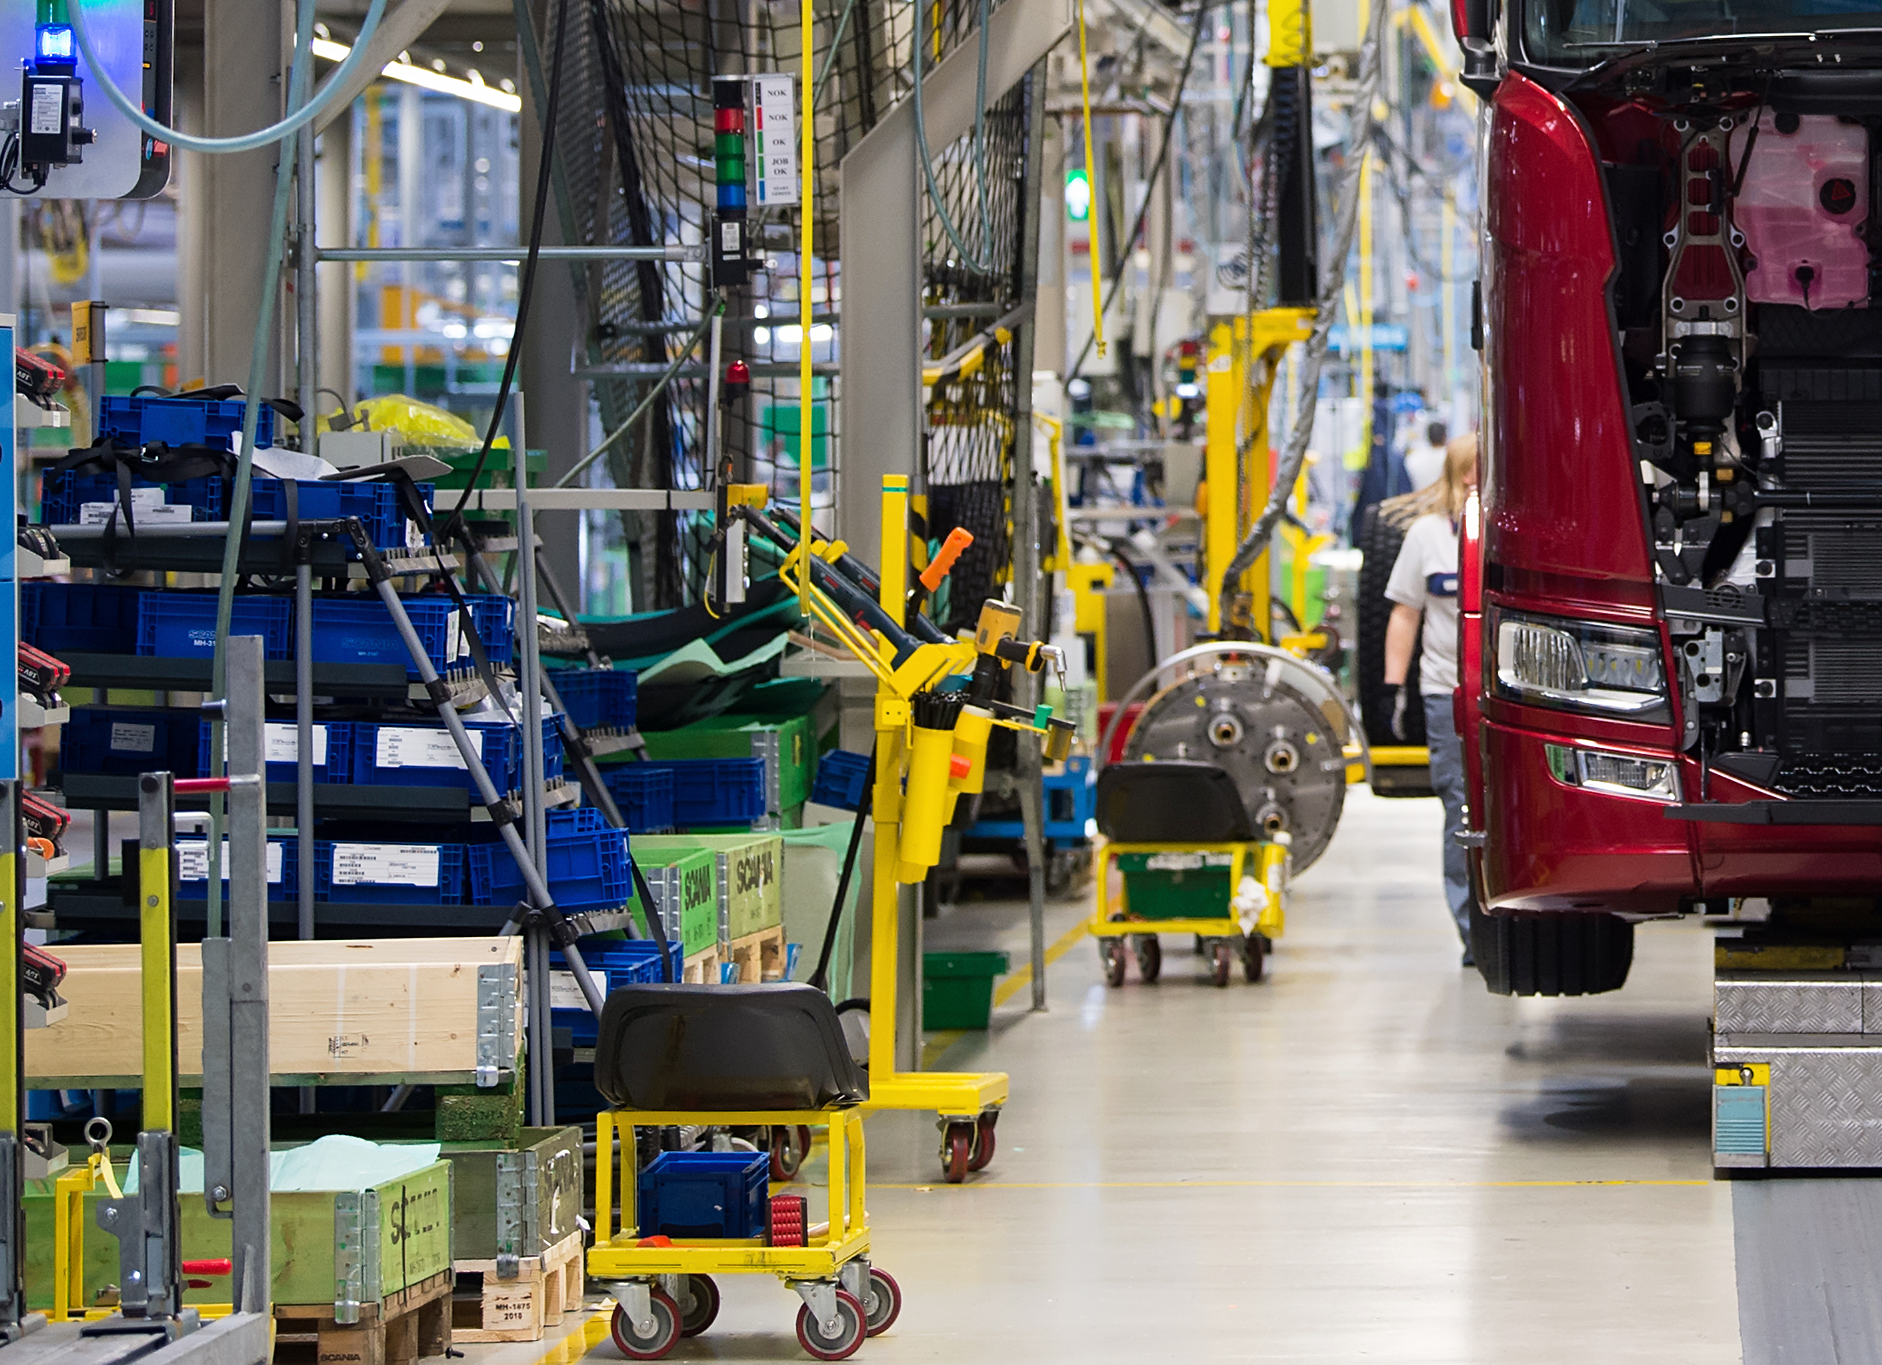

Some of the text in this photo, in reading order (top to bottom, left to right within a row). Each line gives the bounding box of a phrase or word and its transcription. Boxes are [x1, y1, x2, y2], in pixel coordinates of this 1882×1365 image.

[768, 89, 787, 97] NOK
[772, 138, 786, 146] OK
[773, 167, 788, 175] OK
[684, 863, 712, 912] SCANIA
[320, 1353, 361, 1362] SCANIA
